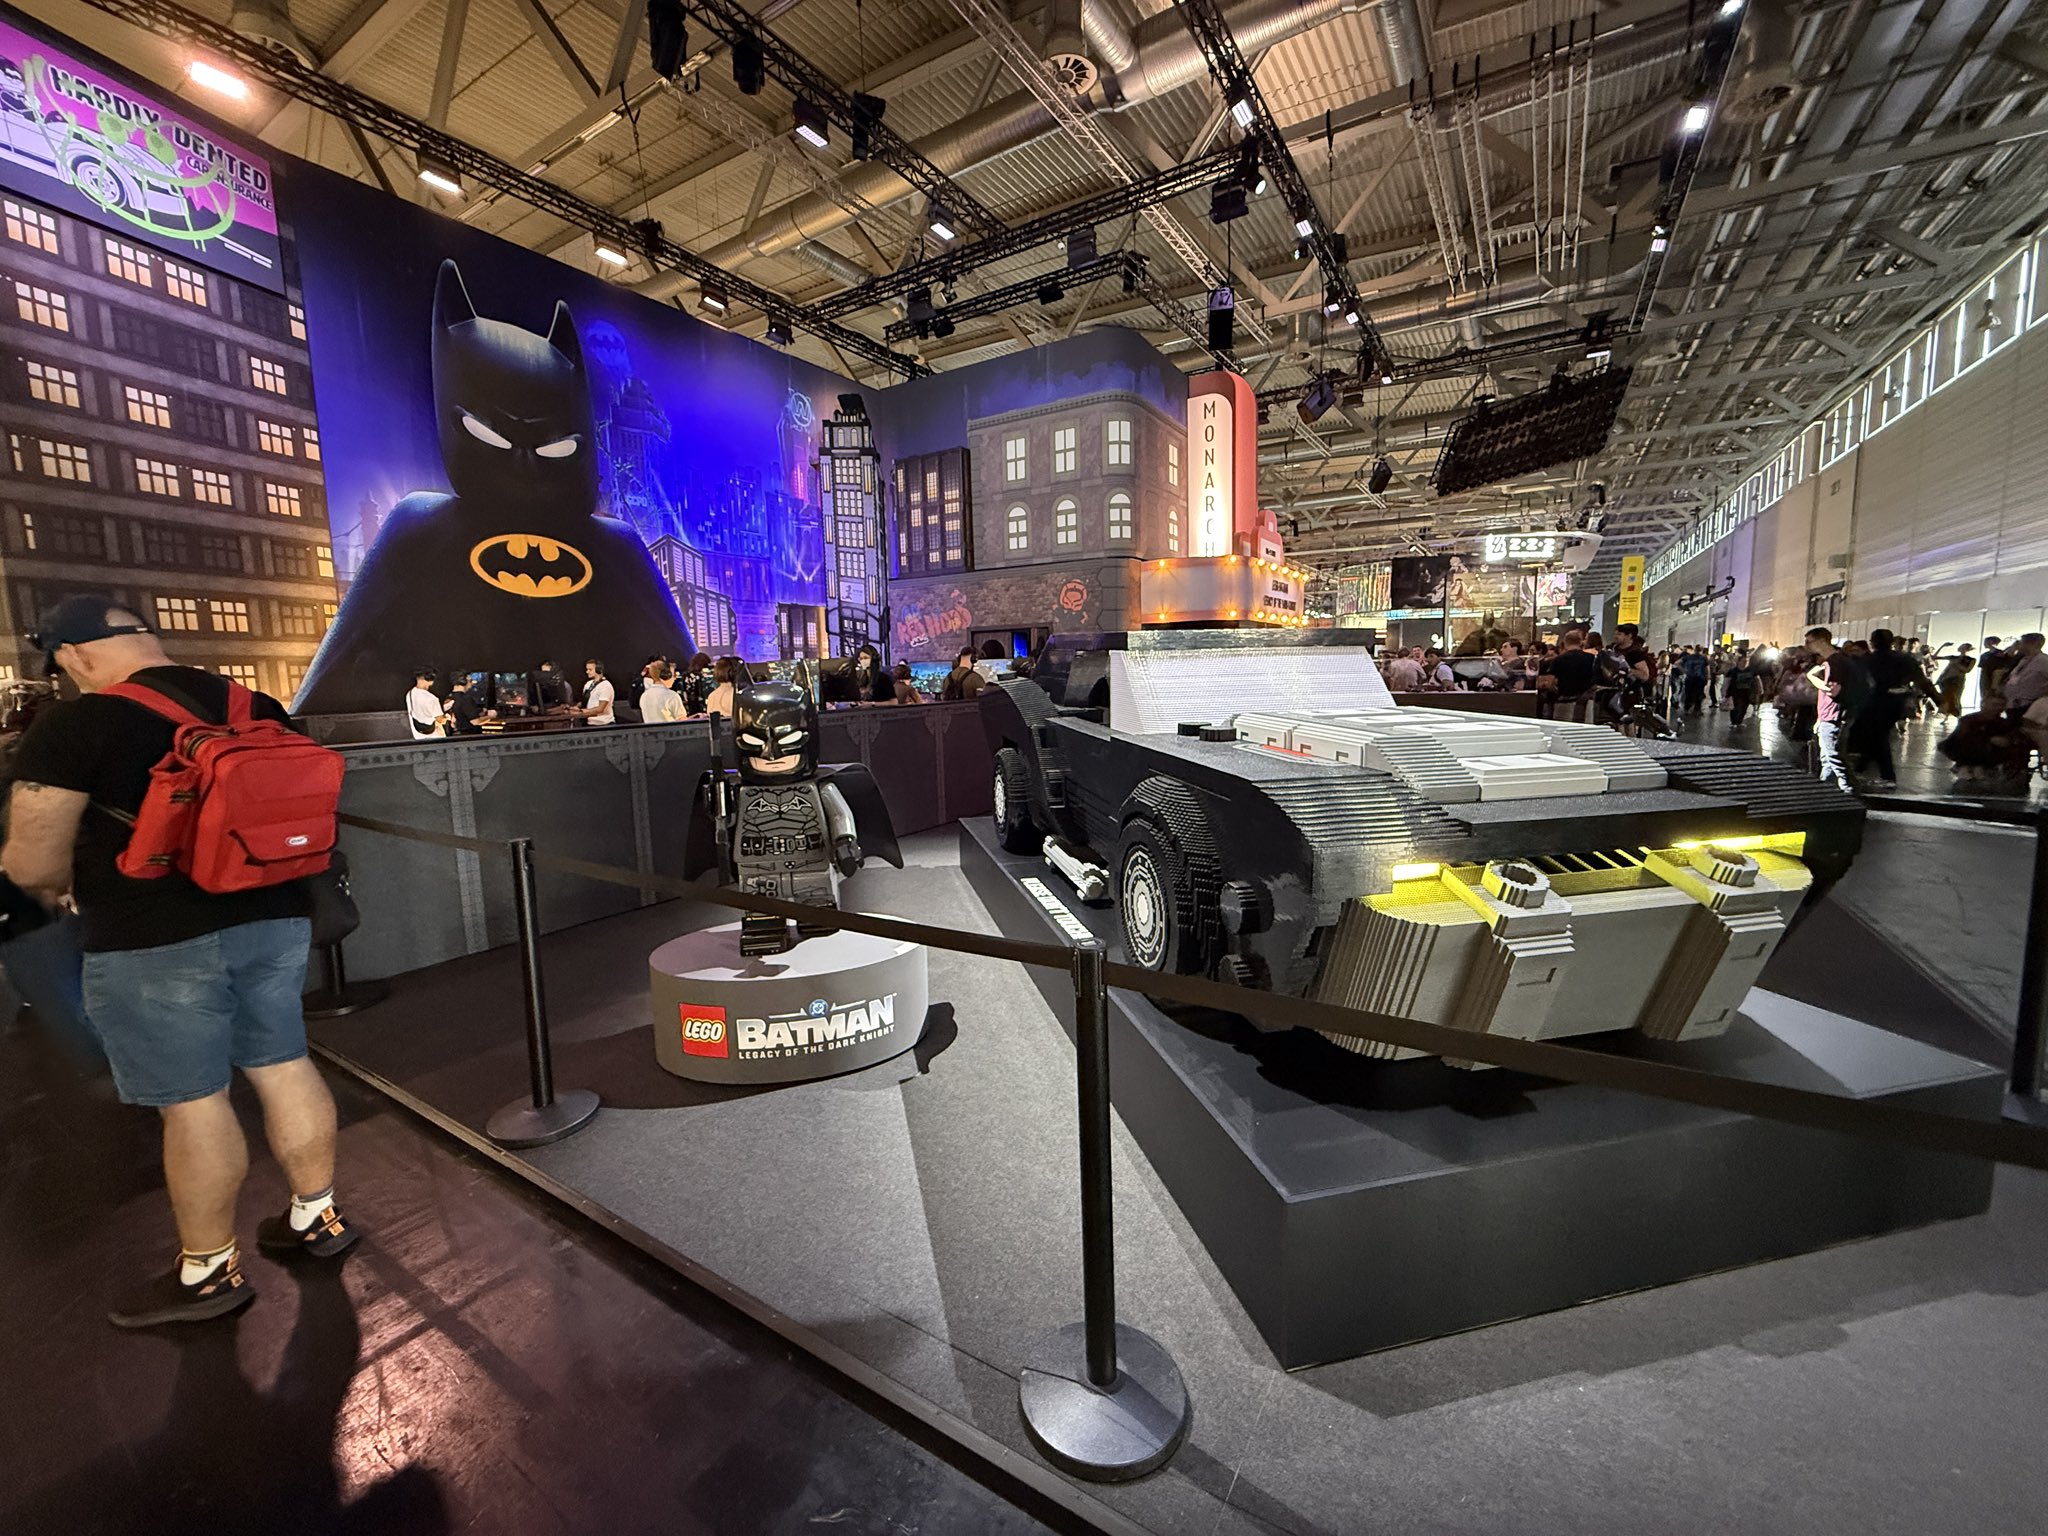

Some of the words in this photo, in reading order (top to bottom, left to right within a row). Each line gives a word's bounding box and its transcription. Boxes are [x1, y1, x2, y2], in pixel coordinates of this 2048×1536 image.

[48, 64, 161, 134] HARDLY
[173, 123, 268, 193] DENTED
[1202, 400, 1216, 558] MONARCH
[683, 1018, 725, 1043] LEGO
[736, 994, 894, 1050] BATMAN
[738, 1050, 780, 1060] LEGACY
[785, 1047, 799, 1057] OF
[803, 1044, 824, 1055] THE
[828, 1037, 856, 1051] DARK
[860, 1025, 895, 1043] KNIGHT
